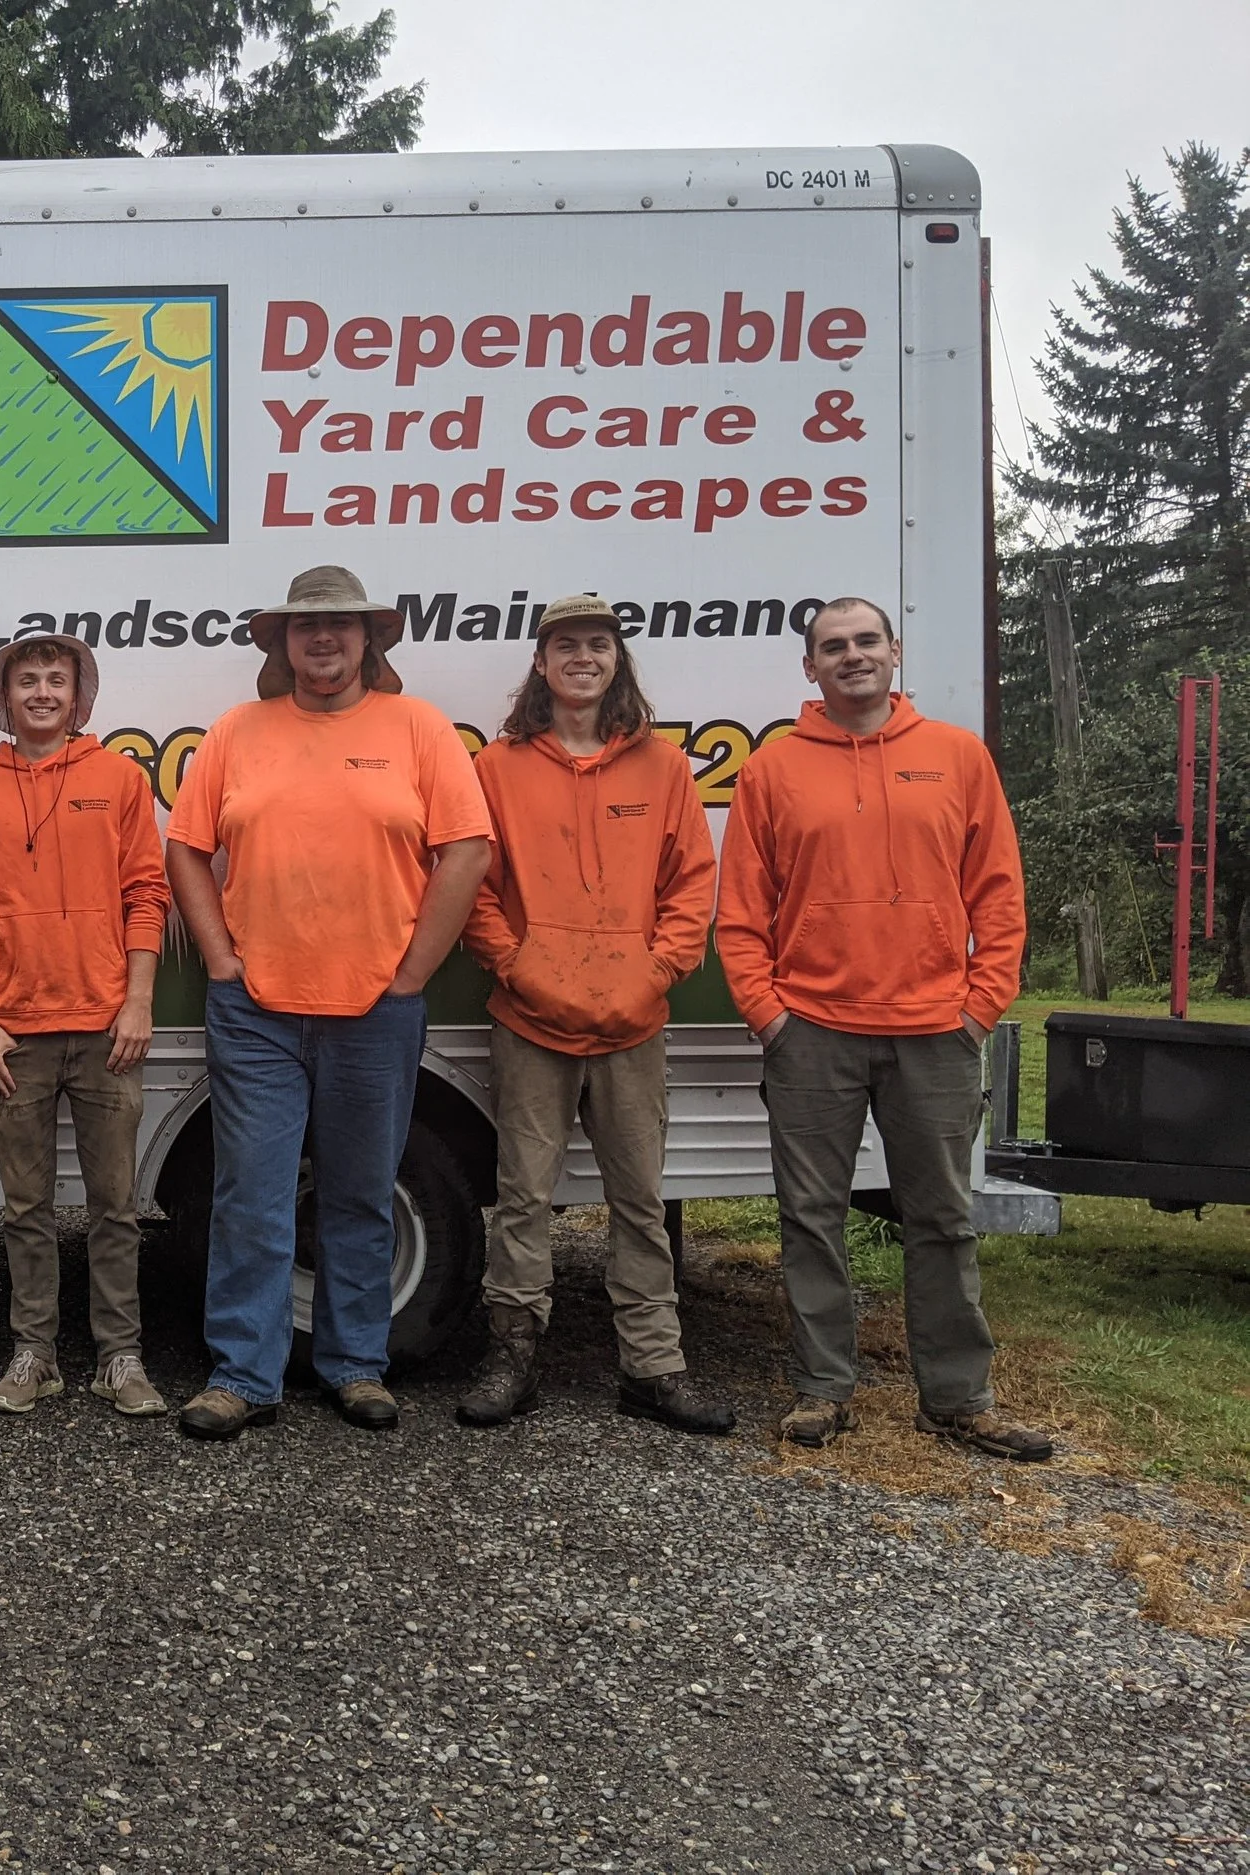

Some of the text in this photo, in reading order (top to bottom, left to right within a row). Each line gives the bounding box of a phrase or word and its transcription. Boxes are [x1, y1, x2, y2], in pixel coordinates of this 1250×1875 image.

[766, 170, 870, 188] DC 2401 M
[261, 291, 866, 386] Dependable
[262, 390, 867, 453] Yard Care &
[262, 468, 867, 532] Landscapes
